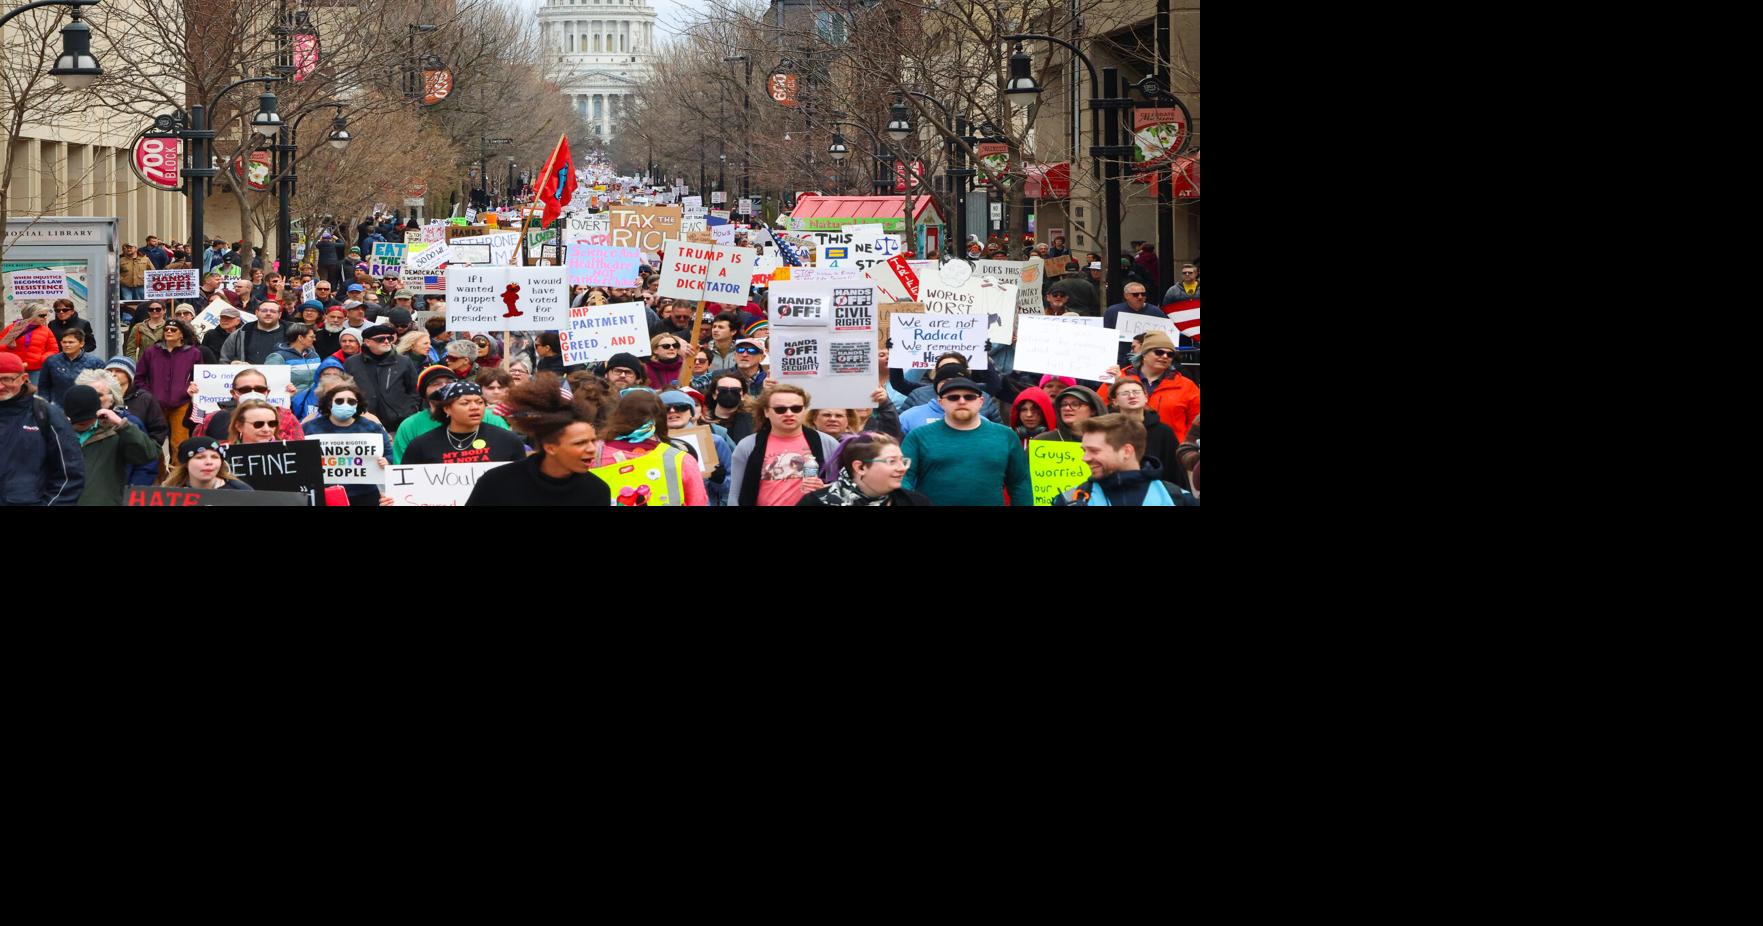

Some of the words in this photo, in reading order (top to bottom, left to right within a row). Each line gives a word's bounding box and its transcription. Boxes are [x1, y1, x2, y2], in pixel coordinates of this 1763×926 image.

[142, 140, 164, 178] 700
[164, 146, 176, 178] BLOCK
[612, 210, 655, 228] TAX
[682, 222, 702, 232] ENS
[612, 228, 679, 250] RICH
[815, 233, 853, 245] THIS
[375, 244, 406, 256] EAT
[679, 247, 724, 261] TRUMP
[731, 254, 742, 263] IS
[378, 257, 400, 265] THE
[674, 262, 707, 274] SUCH
[719, 267, 726, 277] A
[983, 265, 1002, 274] DOES
[152, 281, 191, 291] OFF!
[676, 279, 740, 294] DICKTATOR
[462, 296, 496, 304] puppet
[778, 297, 821, 305] HANDS
[835, 296, 871, 306] OFF!
[927, 288, 975, 304] WORLD'S
[778, 305, 821, 318] OFF!
[835, 307, 871, 318] CIVIL
[570, 315, 634, 330] PARTMENT
[898, 316, 920, 328] We
[929, 320, 949, 328] are
[956, 318, 978, 328] not
[560, 332, 573, 341] OF
[914, 330, 963, 340] Radical
[562, 339, 598, 351] GREED
[611, 336, 635, 346] AND
[902, 340, 920, 350] We
[564, 351, 589, 362] EVIL
[784, 346, 817, 356] OFF!
[782, 356, 819, 366] SOCIAL
[924, 352, 973, 362] Hisy
[203, 370, 216, 379] Do
[320, 446, 350, 456] ANDS
[355, 446, 376, 455] OFF
[461, 448, 490, 456] BODY
[1035, 446, 1075, 464] Guys,
[322, 457, 363, 466] LGBTQ
[320, 468, 366, 477] PEOPLE
[393, 468, 414, 486] I
[424, 466, 486, 486] Woul
[1035, 466, 1084, 477] worried
[128, 490, 202, 506] HATE
